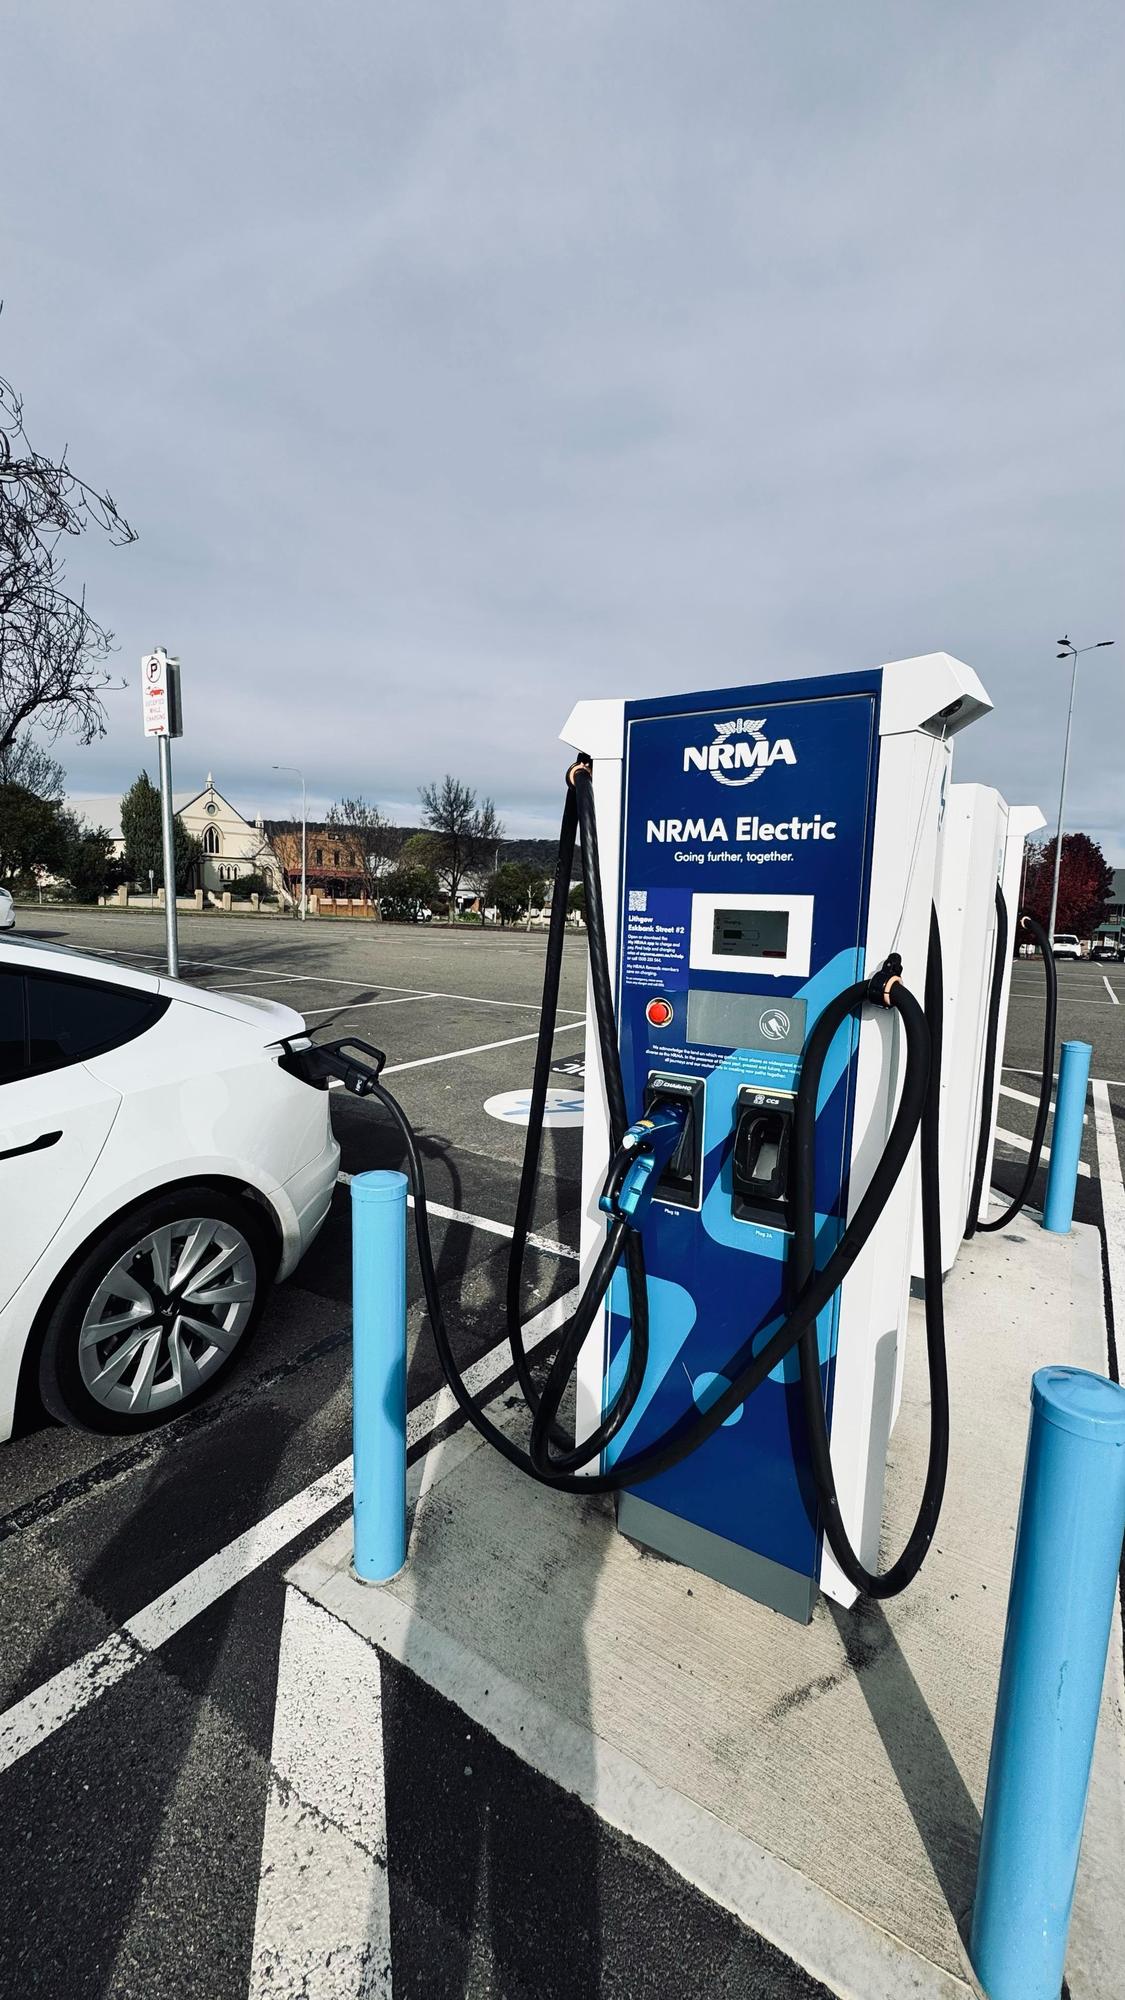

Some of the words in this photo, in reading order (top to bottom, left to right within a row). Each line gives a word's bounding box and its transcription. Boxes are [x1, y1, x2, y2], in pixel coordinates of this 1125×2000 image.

[150, 662, 158, 678] P
[683, 739, 797, 772] NRMA
[646, 818, 728, 842] NRMA
[736, 814, 836, 842] Electric
[674, 852, 704, 864] Going
[707, 851, 744, 863] further,
[746, 851, 794, 864] together.
[628, 915, 654, 924] Lithgow
[755, 1230, 766, 1238] Plug
